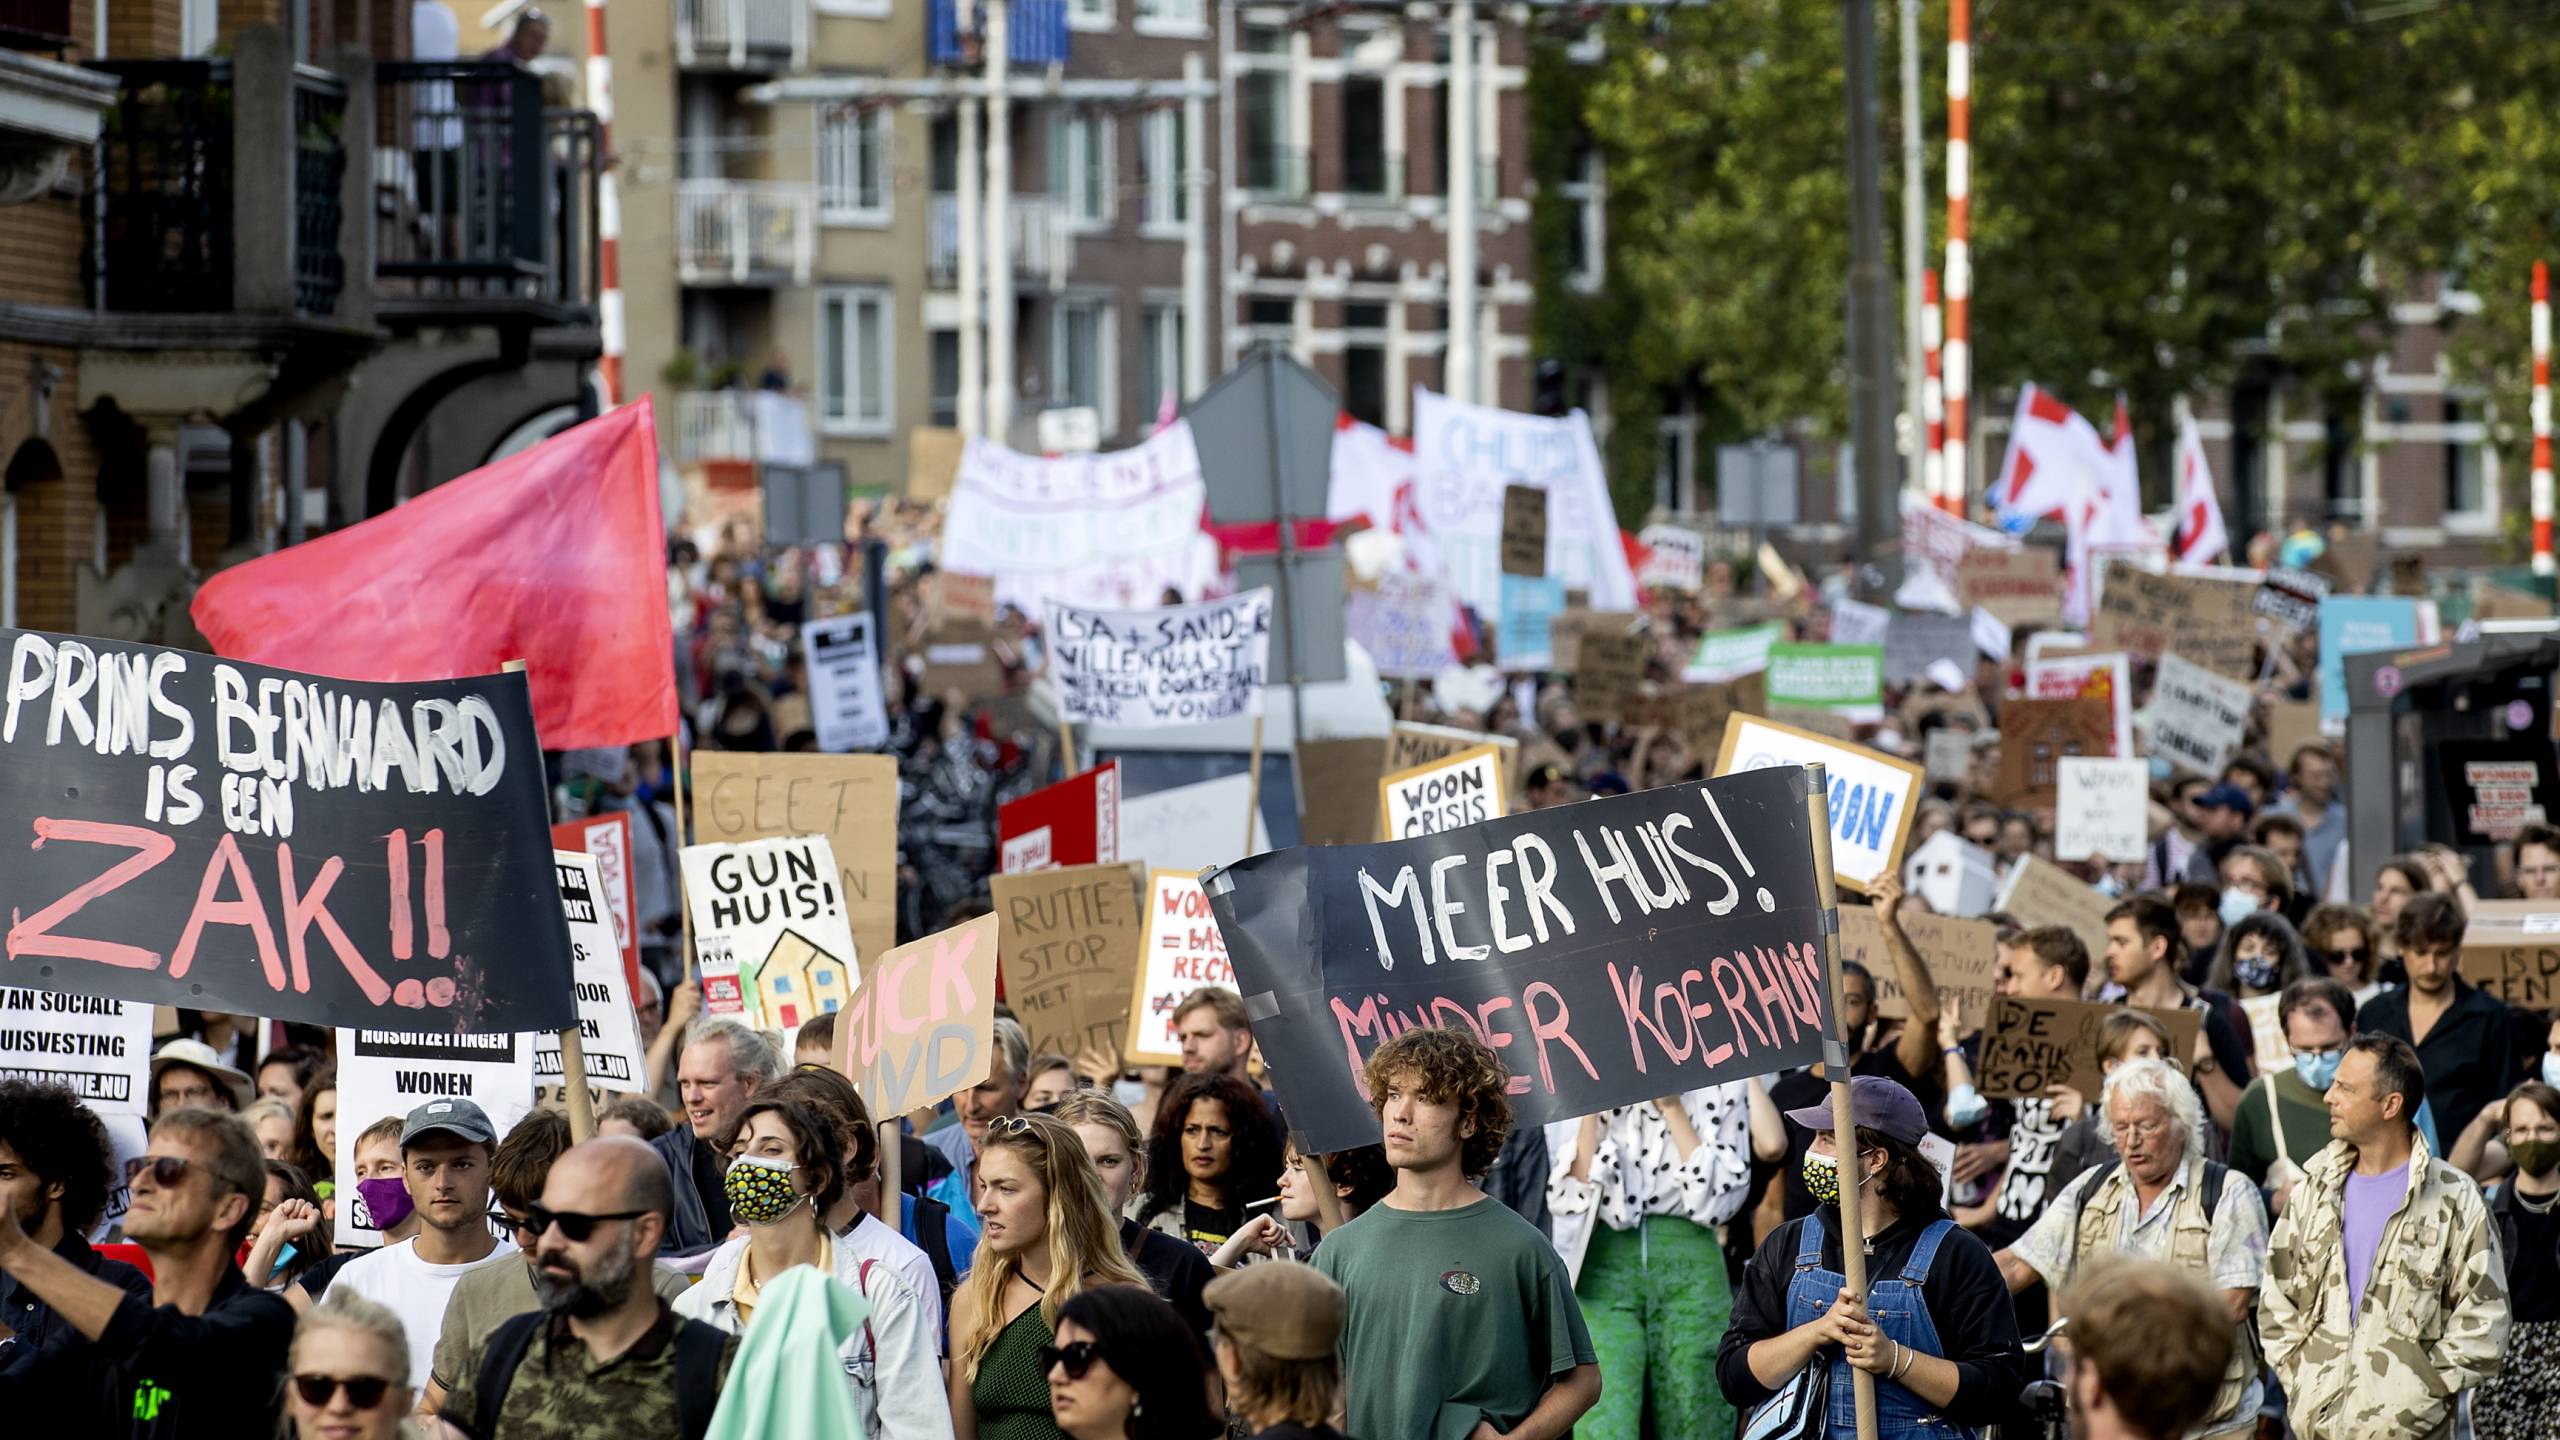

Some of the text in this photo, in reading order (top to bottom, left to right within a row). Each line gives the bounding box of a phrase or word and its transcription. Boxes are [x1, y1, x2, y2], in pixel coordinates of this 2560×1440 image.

[1154, 603, 1270, 649] SANDER
[3, 633, 507, 796] PRINS BERNHARD
[145, 763, 295, 837] IS EEN
[1402, 766, 1483, 811] WOON
[1405, 795, 1486, 838] CRISIS
[565, 868, 587, 890] DE
[711, 846, 818, 895] GUN
[1358, 787, 1776, 970] MEER HUIS!
[711, 881, 837, 929] HUIS!
[1018, 934, 1108, 984] STOP
[2501, 947, 2527, 977] IS
[40, 990, 124, 1017] SOCIALE
[846, 928, 978, 1083] FUCK
[1021, 984, 1072, 1013] MET
[395, 1070, 473, 1097] WONEN
